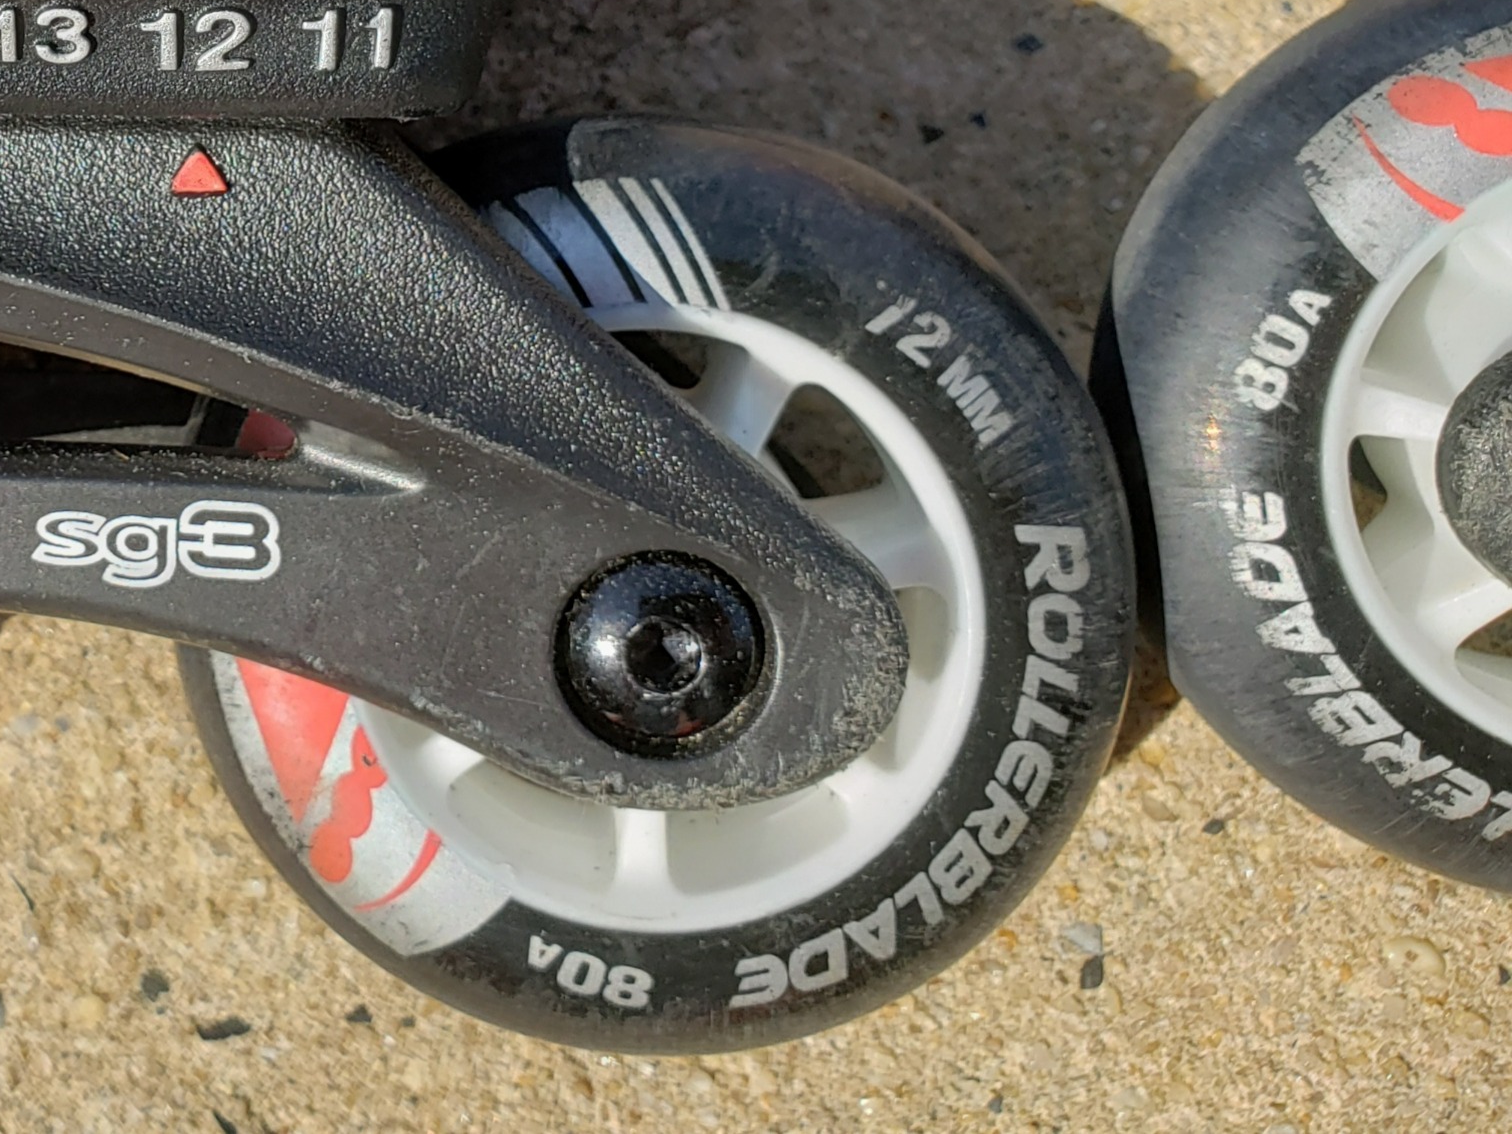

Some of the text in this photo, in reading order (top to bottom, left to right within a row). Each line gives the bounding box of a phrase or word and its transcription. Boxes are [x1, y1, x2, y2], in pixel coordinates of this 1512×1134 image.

[140, 10, 254, 71] 12
[303, 7, 399, 69] 11
[31, 499, 281, 589] sg3
[729, 522, 1087, 1008] ROLLERBLADE
[526, 933, 655, 1010] 80A
